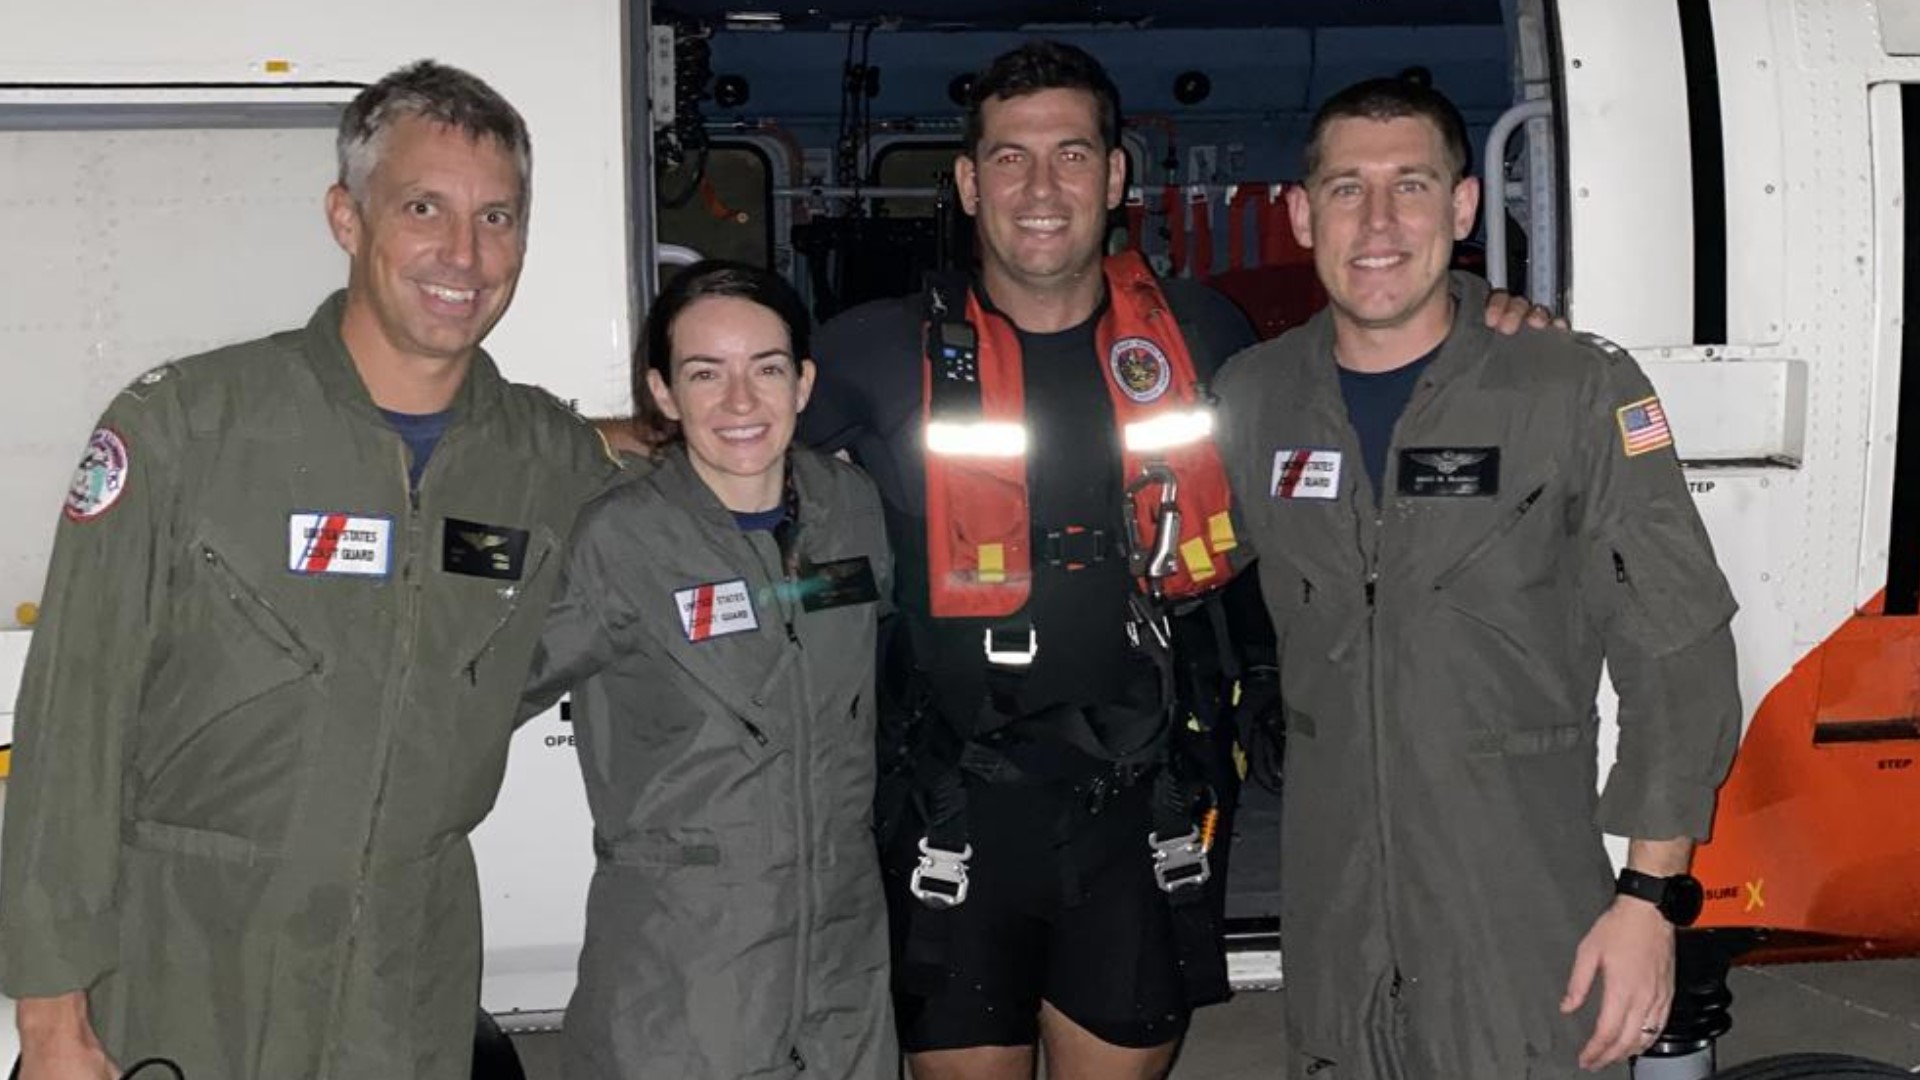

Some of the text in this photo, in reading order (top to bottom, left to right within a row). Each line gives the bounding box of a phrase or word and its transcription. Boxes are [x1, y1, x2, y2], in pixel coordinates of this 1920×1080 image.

[1689, 481, 1716, 493] TEP
[341, 529, 377, 543] STATES
[341, 548, 375, 562] GUARD
[721, 610, 748, 621] GUARD
[544, 735, 576, 747] OPE
[1878, 758, 1912, 770] STEP
